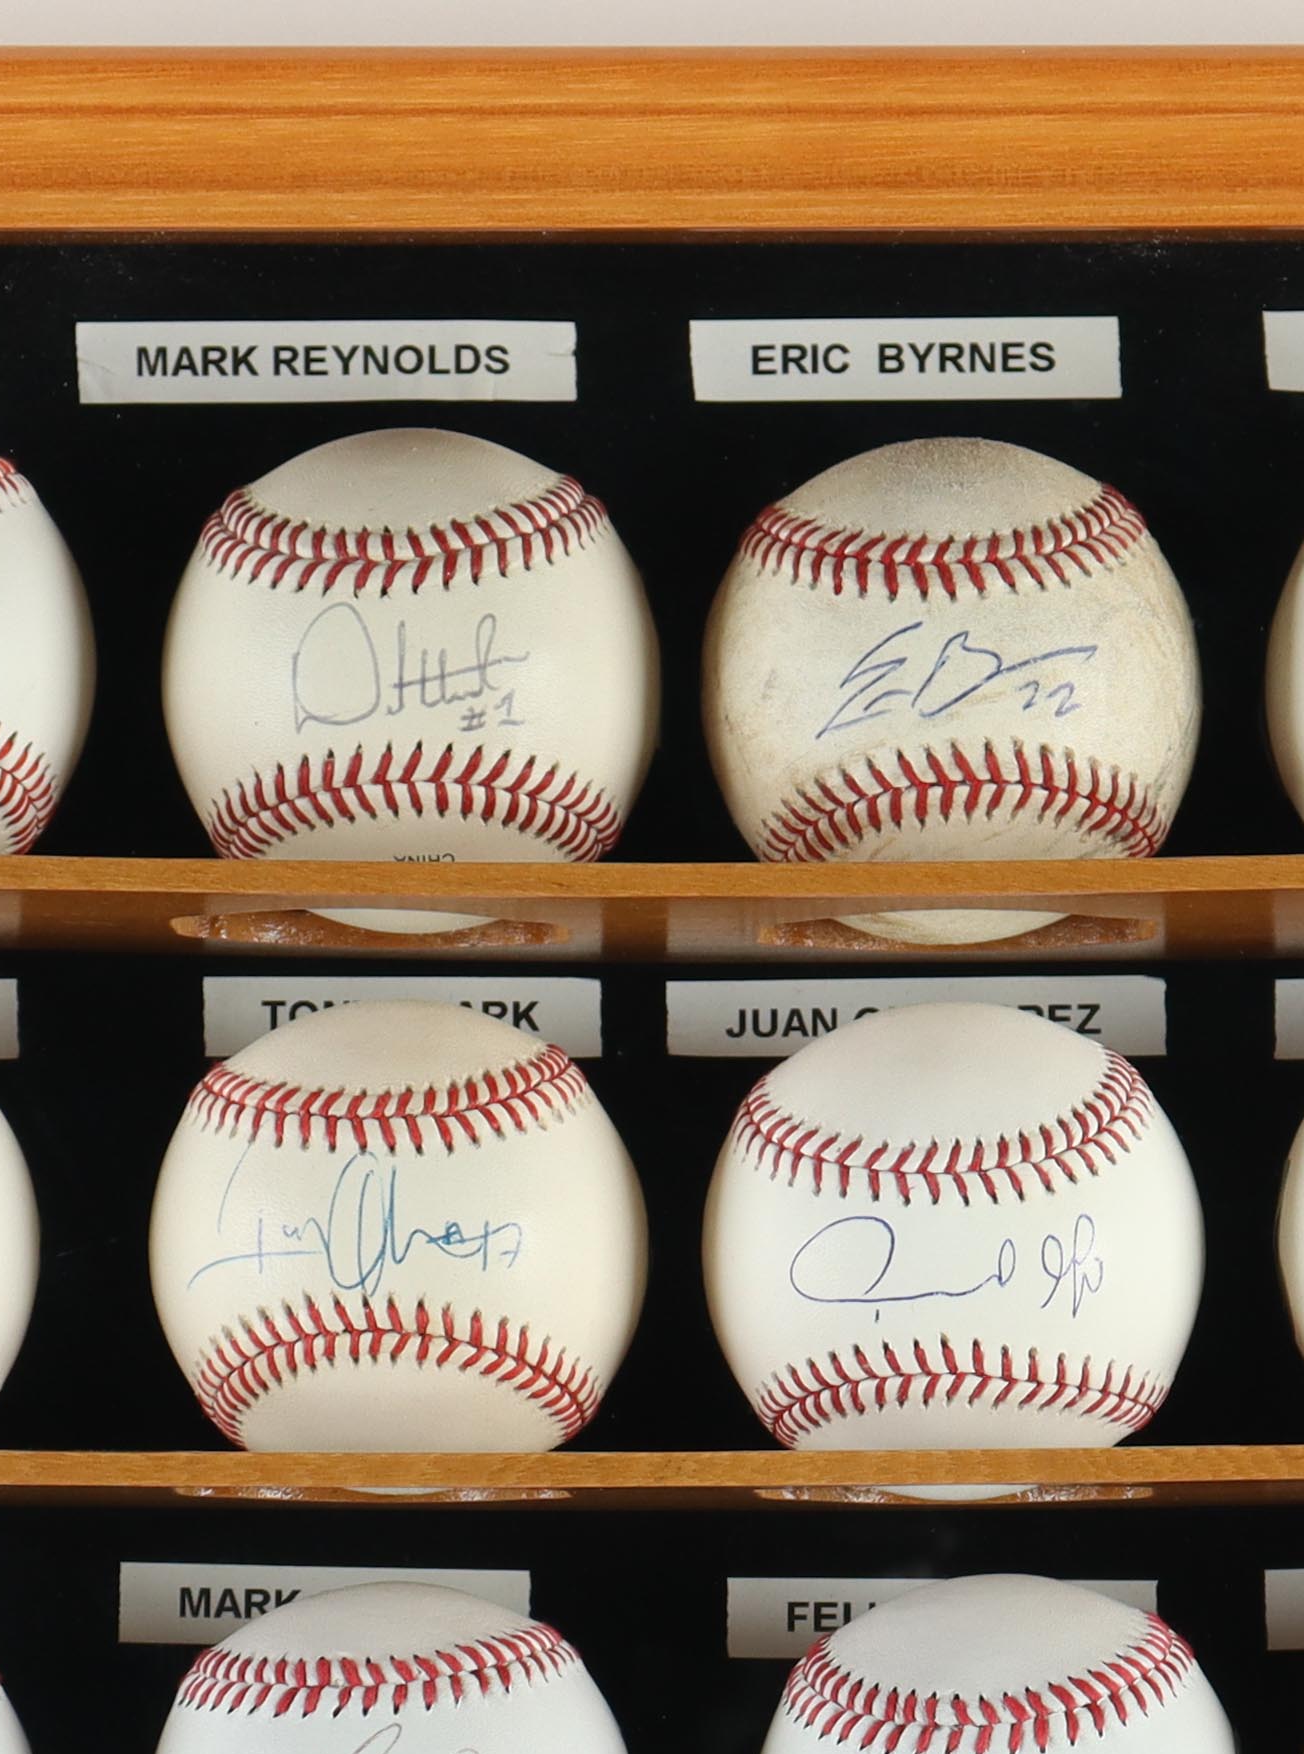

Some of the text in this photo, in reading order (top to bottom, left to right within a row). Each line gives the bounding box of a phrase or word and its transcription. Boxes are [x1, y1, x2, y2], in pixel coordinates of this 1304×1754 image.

[137, 344, 510, 377] MARK REYNOLDS
[751, 342, 1056, 376] ERIC BYRNES
[725, 1007, 838, 1039] JUAN
